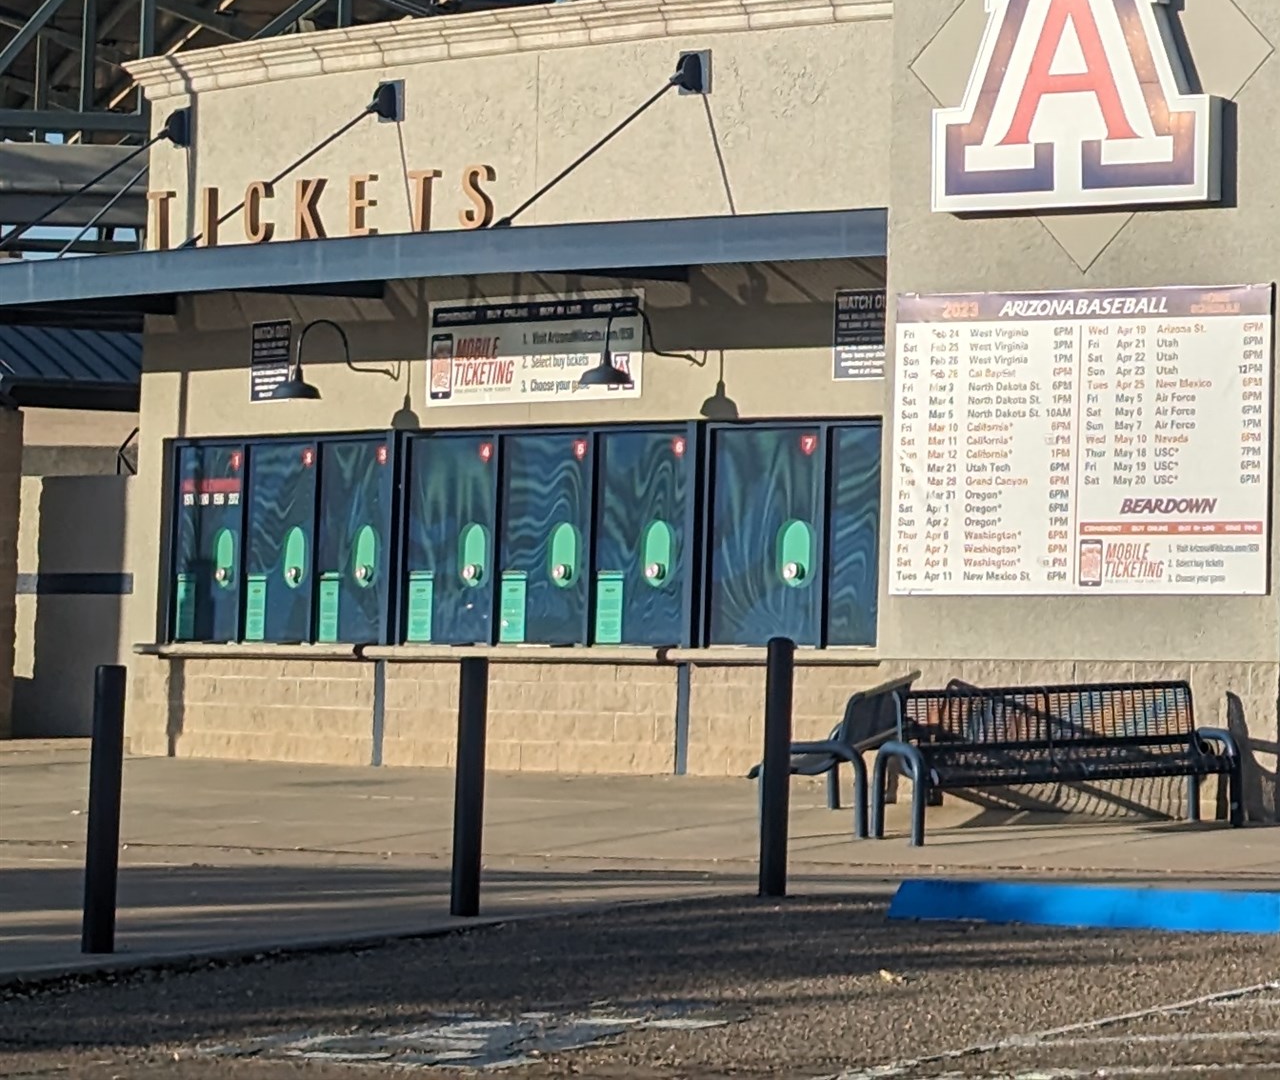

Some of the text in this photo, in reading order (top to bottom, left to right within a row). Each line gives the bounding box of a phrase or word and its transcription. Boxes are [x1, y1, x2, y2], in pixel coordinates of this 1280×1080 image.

[146, 164, 497, 251] TICKETS
[456, 336, 500, 359] MOBILE
[1088, 336, 1263, 350] Fri Apr 21 Utah 6PM
[1087, 350, 1263, 363] Sat Apr 22 Utah 6PM
[454, 360, 514, 386] TICKETING
[1116, 367, 1132, 377] Apr
[1134, 366, 1145, 376] 23
[1156, 366, 1178, 375] Utah
[902, 397, 916, 406] Sat
[929, 396, 946, 406] Mar
[948, 396, 954, 405] 4
[967, 395, 993, 405] North
[995, 395, 1027, 405] Dakota
[1052, 394, 1072, 404] 1PM
[1087, 391, 1262, 404] Fri May 5 Air Force 6PM
[901, 411, 919, 420] Sun
[928, 410, 946, 419] Mar
[967, 409, 993, 419] North
[995, 409, 1027, 418] Dakota
[1045, 408, 1071, 418] 10AM
[1086, 408, 1101, 417] Sat
[1115, 407, 1135, 418] May
[1155, 407, 1169, 416] Air
[1170, 406, 1196, 416] Force
[1241, 404, 1262, 414] 6PM
[1086, 418, 1262, 432] Sun May 7 Air Force 1PM
[1114, 448, 1135, 459] May
[1241, 446, 1261, 456] 7PM
[1084, 462, 1097, 471] Fri
[1113, 462, 1135, 473] May
[1136, 461, 1146, 470] 19
[1240, 460, 1260, 469] 6PM
[1084, 475, 1100, 485] Sat
[1113, 475, 1134, 486] May
[1135, 475, 1146, 484] 20
[1240, 474, 1260, 483] 6PM
[1106, 543, 1150, 560] MOBILE
[1105, 560, 1164, 578] TICKETING
[896, 571, 917, 581] Tues
[924, 572, 940, 581] Apr
[942, 571, 952, 581] 11
[963, 571, 983, 581] New
[986, 571, 1018, 581] Mexico
[1047, 571, 1067, 581] 6PM
